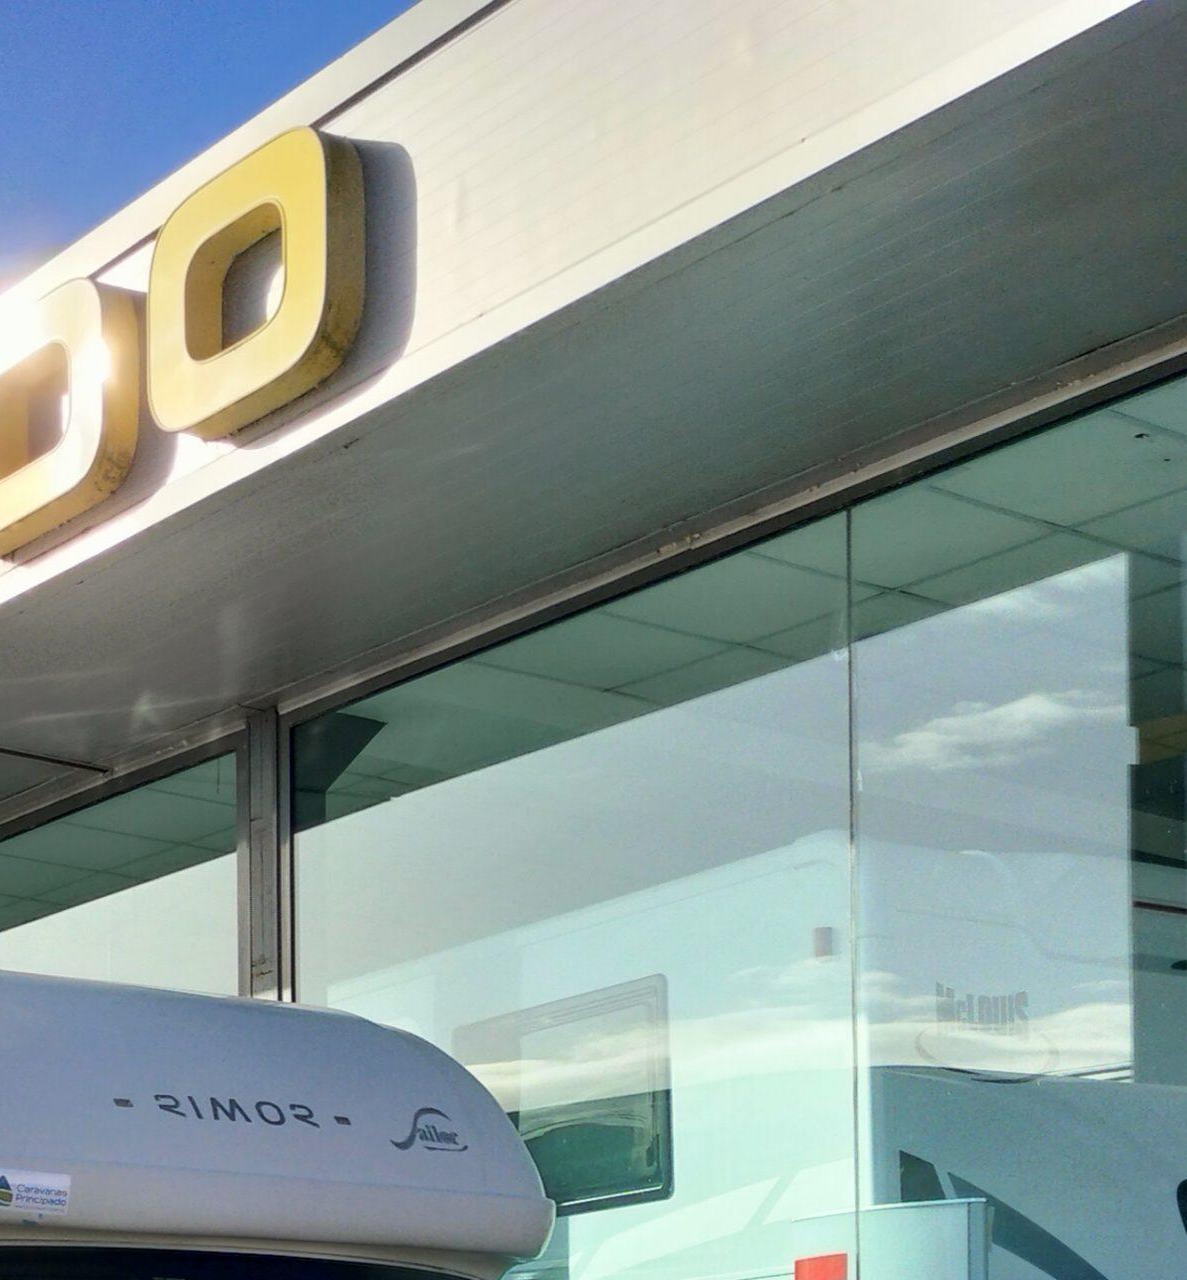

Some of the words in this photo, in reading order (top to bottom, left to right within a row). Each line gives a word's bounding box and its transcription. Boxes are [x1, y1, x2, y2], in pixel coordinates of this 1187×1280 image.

[154, 1094, 320, 1128] RIMOR
[16, 1184, 68, 1197] Caravanas
[15, 1193, 67, 1207] Principado
